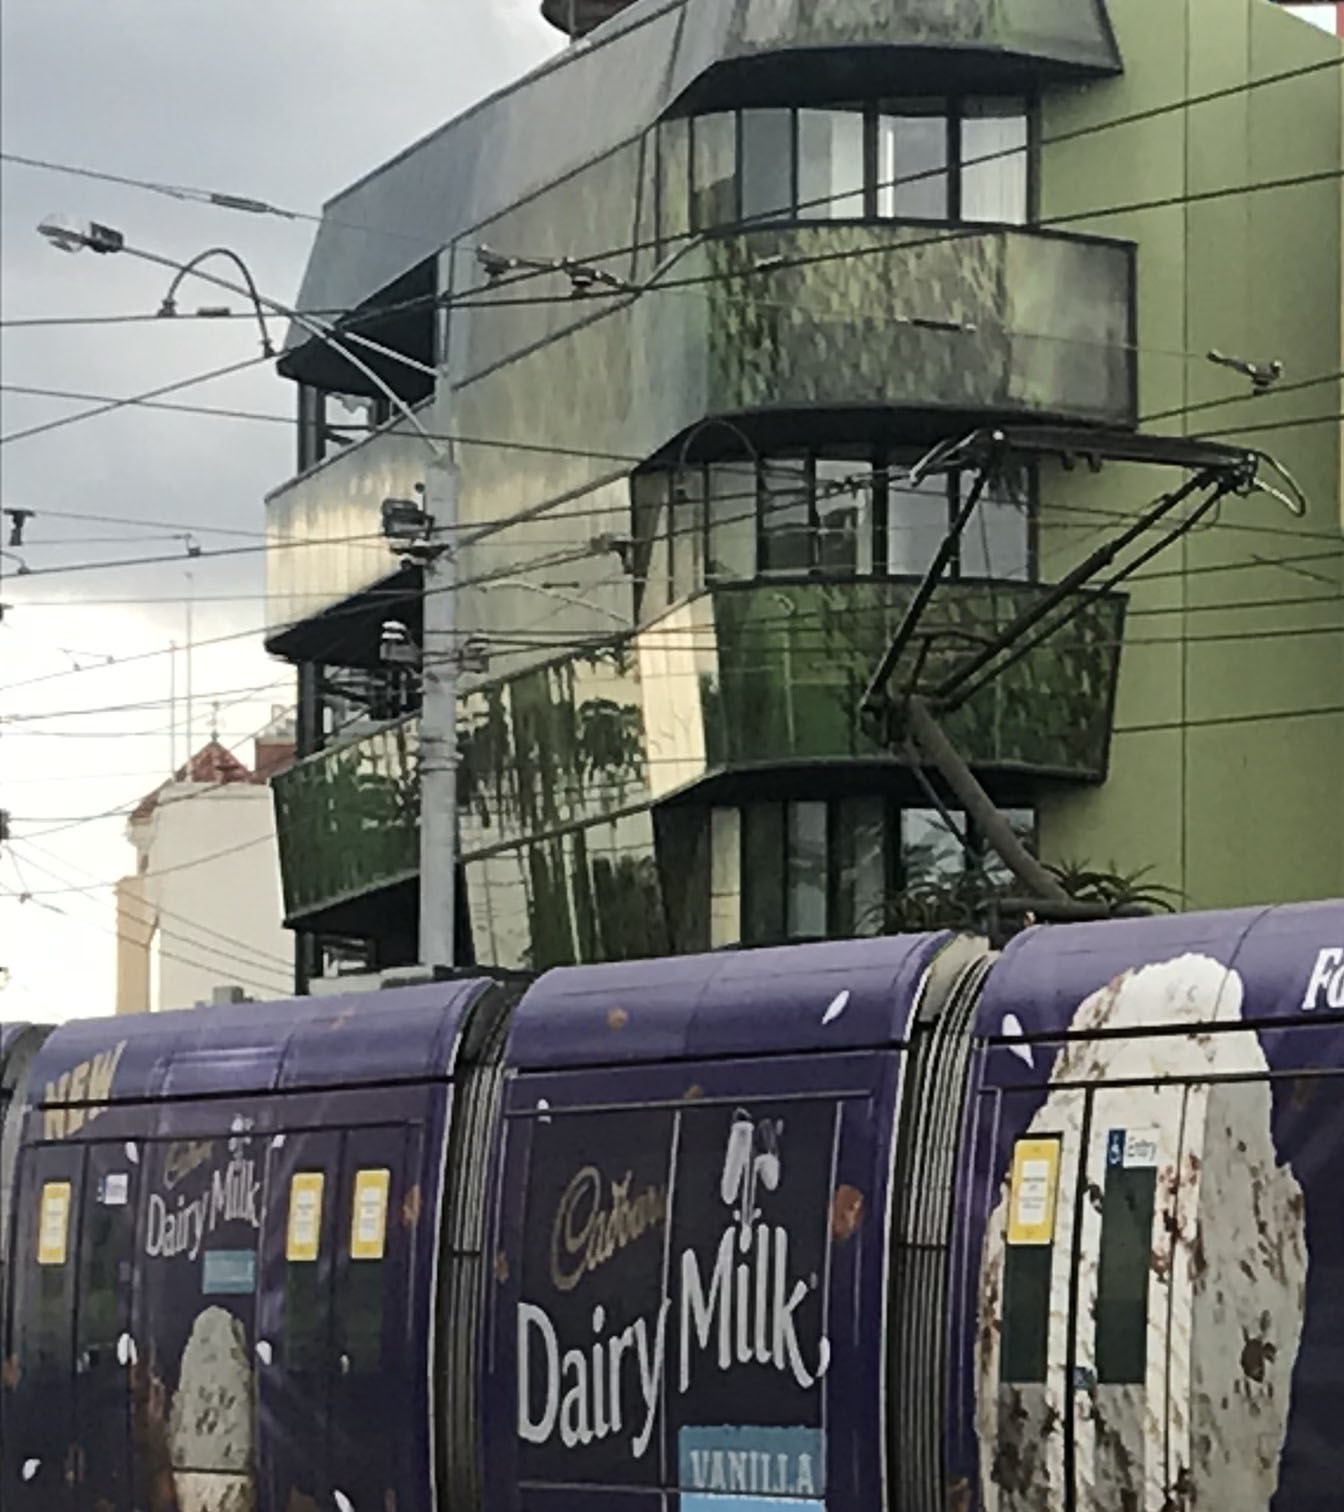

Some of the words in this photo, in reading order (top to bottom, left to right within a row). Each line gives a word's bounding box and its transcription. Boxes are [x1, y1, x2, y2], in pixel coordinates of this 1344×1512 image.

[145, 1191, 209, 1261] Dairy
[208, 1158, 262, 1231] Milk
[517, 1297, 671, 1459] Dairy
[679, 1222, 832, 1394] Milk
[689, 1449, 816, 1500] VANILLA
